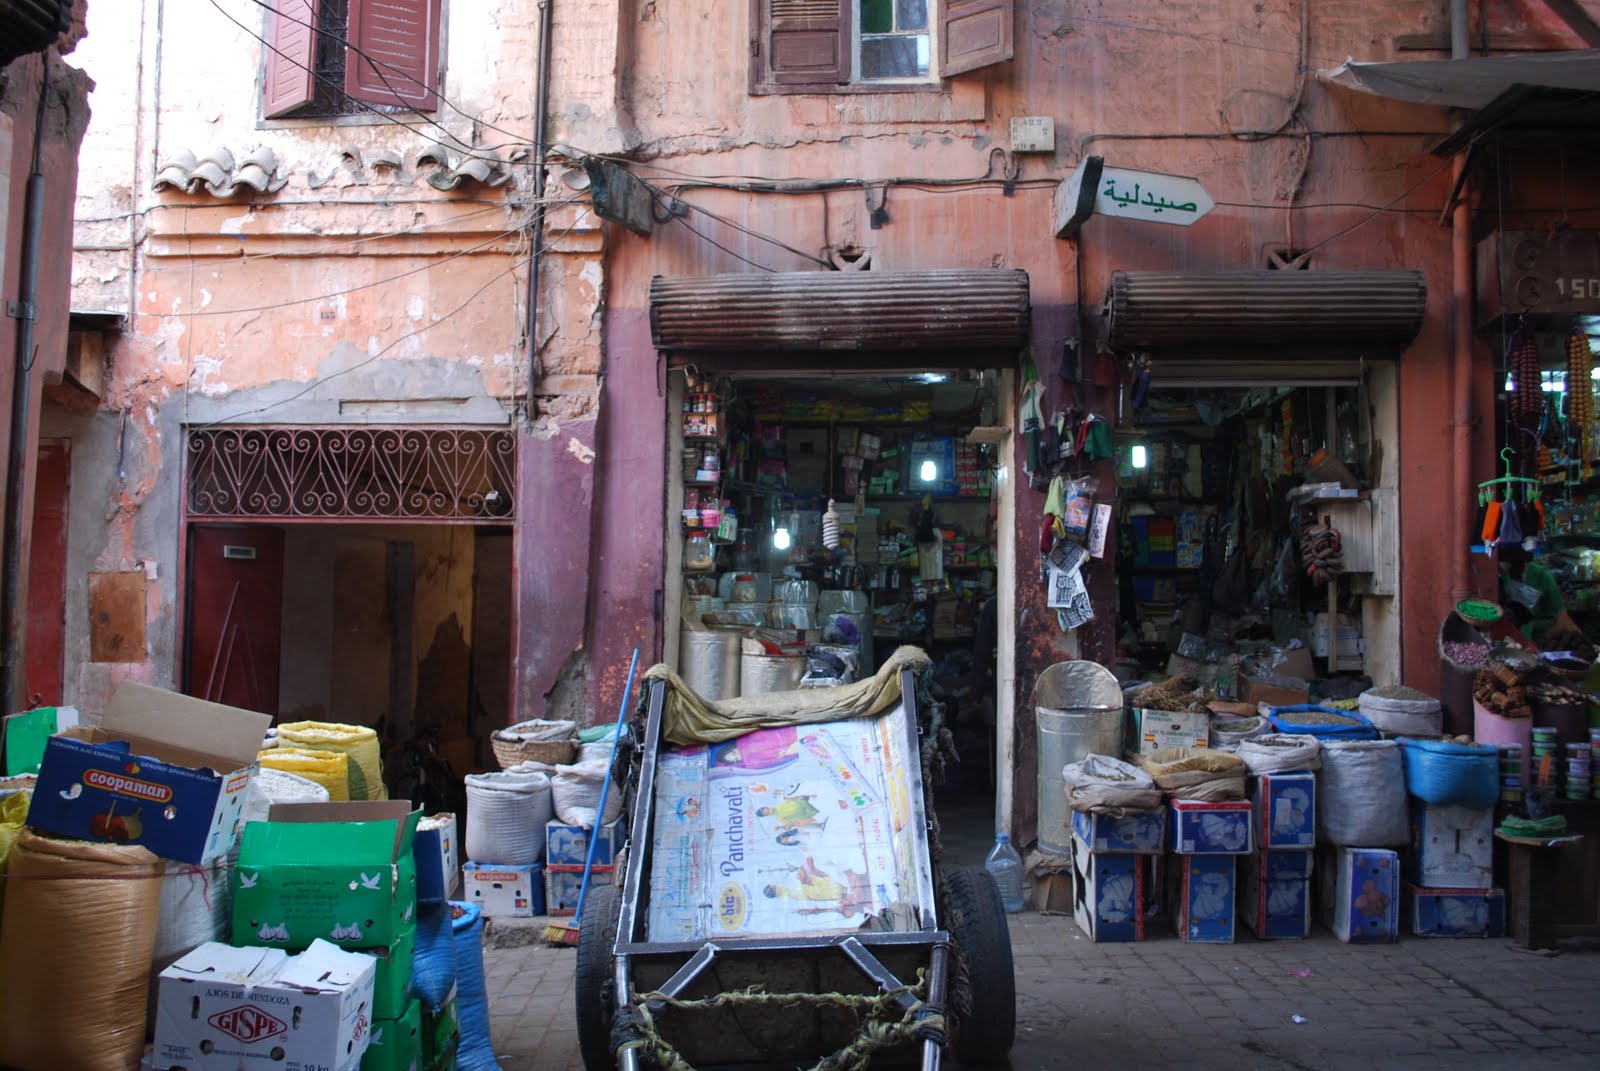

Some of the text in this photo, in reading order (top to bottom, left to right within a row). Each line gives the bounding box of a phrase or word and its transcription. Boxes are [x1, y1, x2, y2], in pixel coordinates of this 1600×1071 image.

[1103, 179, 1197, 213] صيدلية
[51, 740, 79, 751] GENUINO
[140, 761, 168, 772] GENUINE
[168, 767, 196, 778] SPANISH
[89, 772, 167, 799] coopaman
[720, 785, 745, 877] Panchavati
[205, 988, 229, 997] AJOS
[231, 991, 245, 1000] DE
[218, 1008, 278, 1040] GISPE
